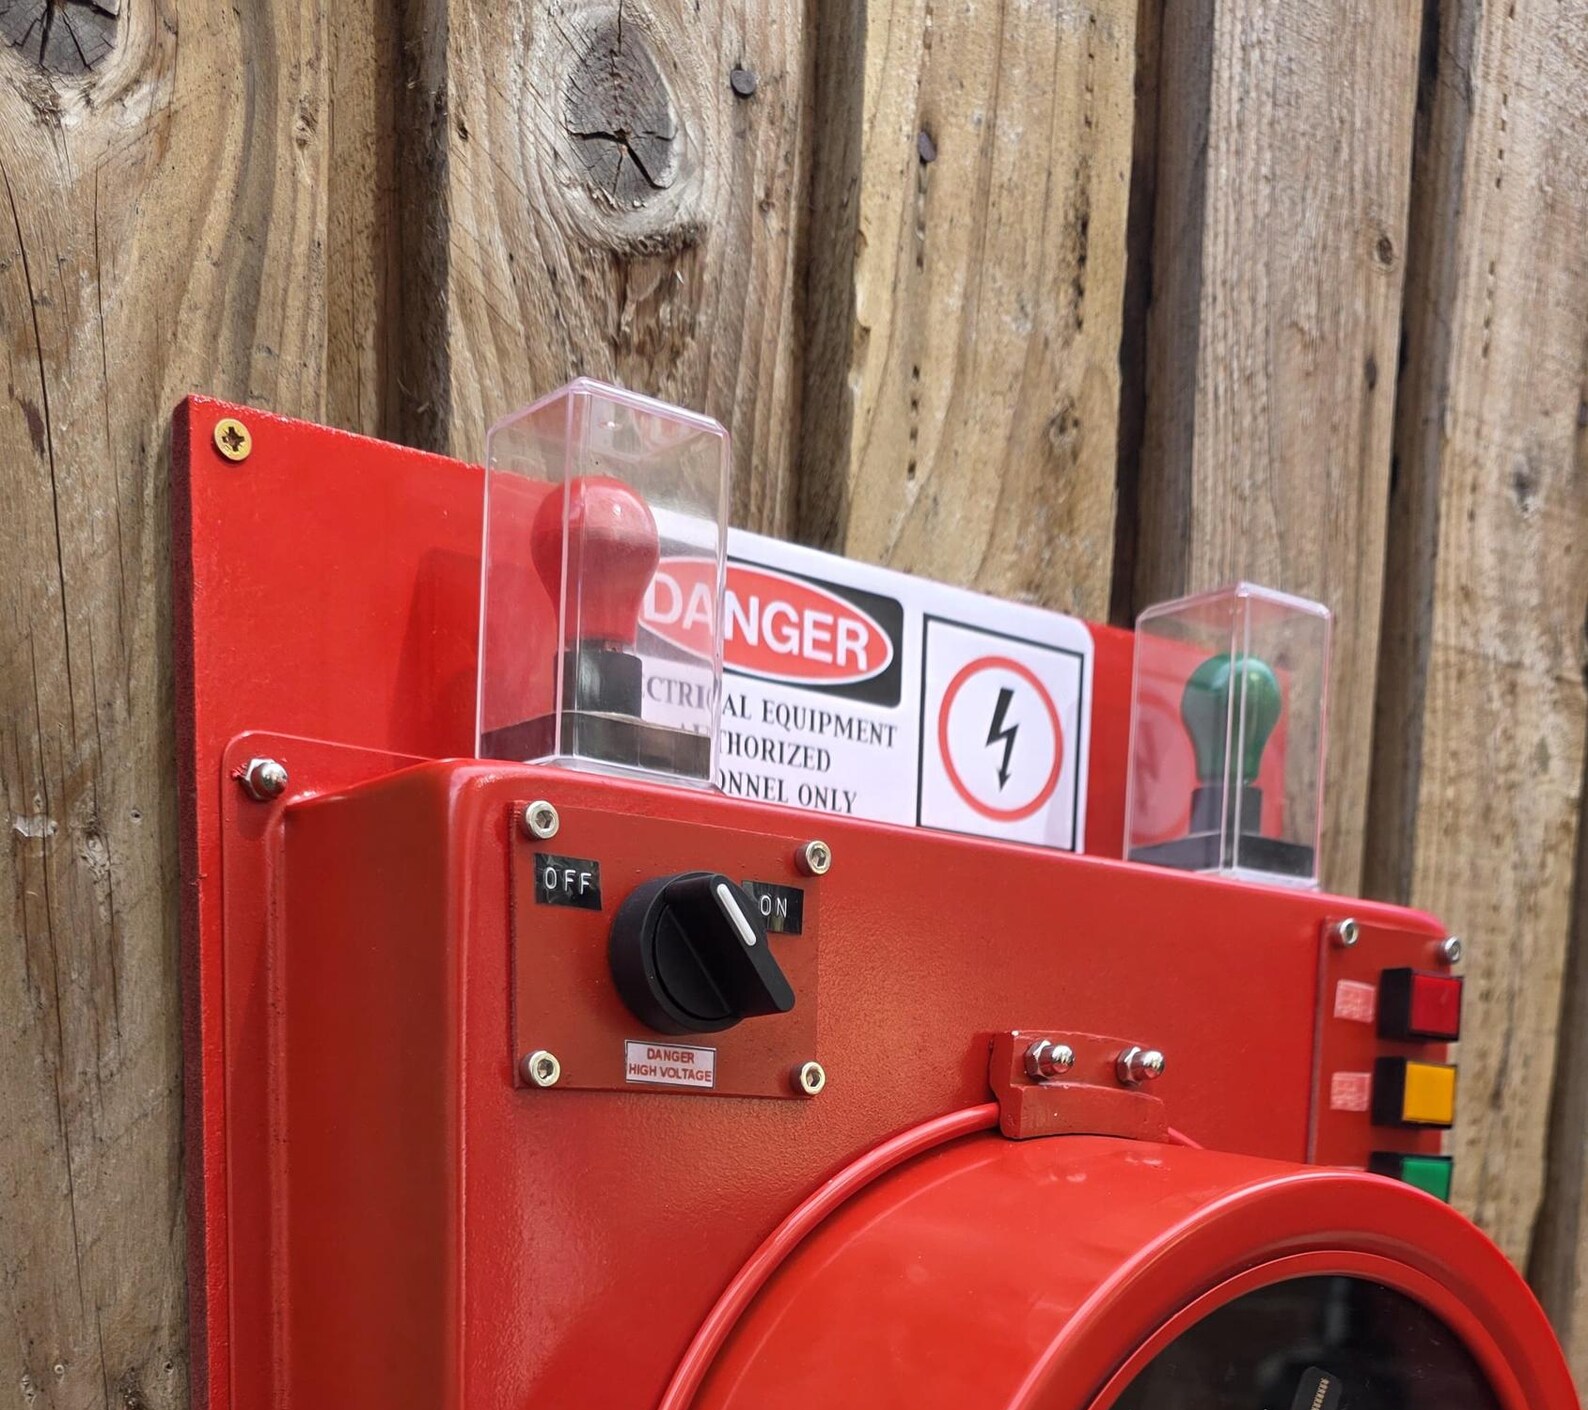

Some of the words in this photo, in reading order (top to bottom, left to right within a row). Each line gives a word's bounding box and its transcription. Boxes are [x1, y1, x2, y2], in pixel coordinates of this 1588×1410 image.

[643, 572, 869, 672] DANGER
[642, 675, 752, 721] CTRIAL
[762, 698, 898, 750] EQUIPMENT
[798, 783, 857, 815] ONLY
[543, 866, 593, 896] OFF
[760, 893, 788, 919] ON
[646, 1047, 695, 1064] DANGER
[628, 1062, 657, 1077] HIGH
[659, 1065, 712, 1083] VOLTAGE
